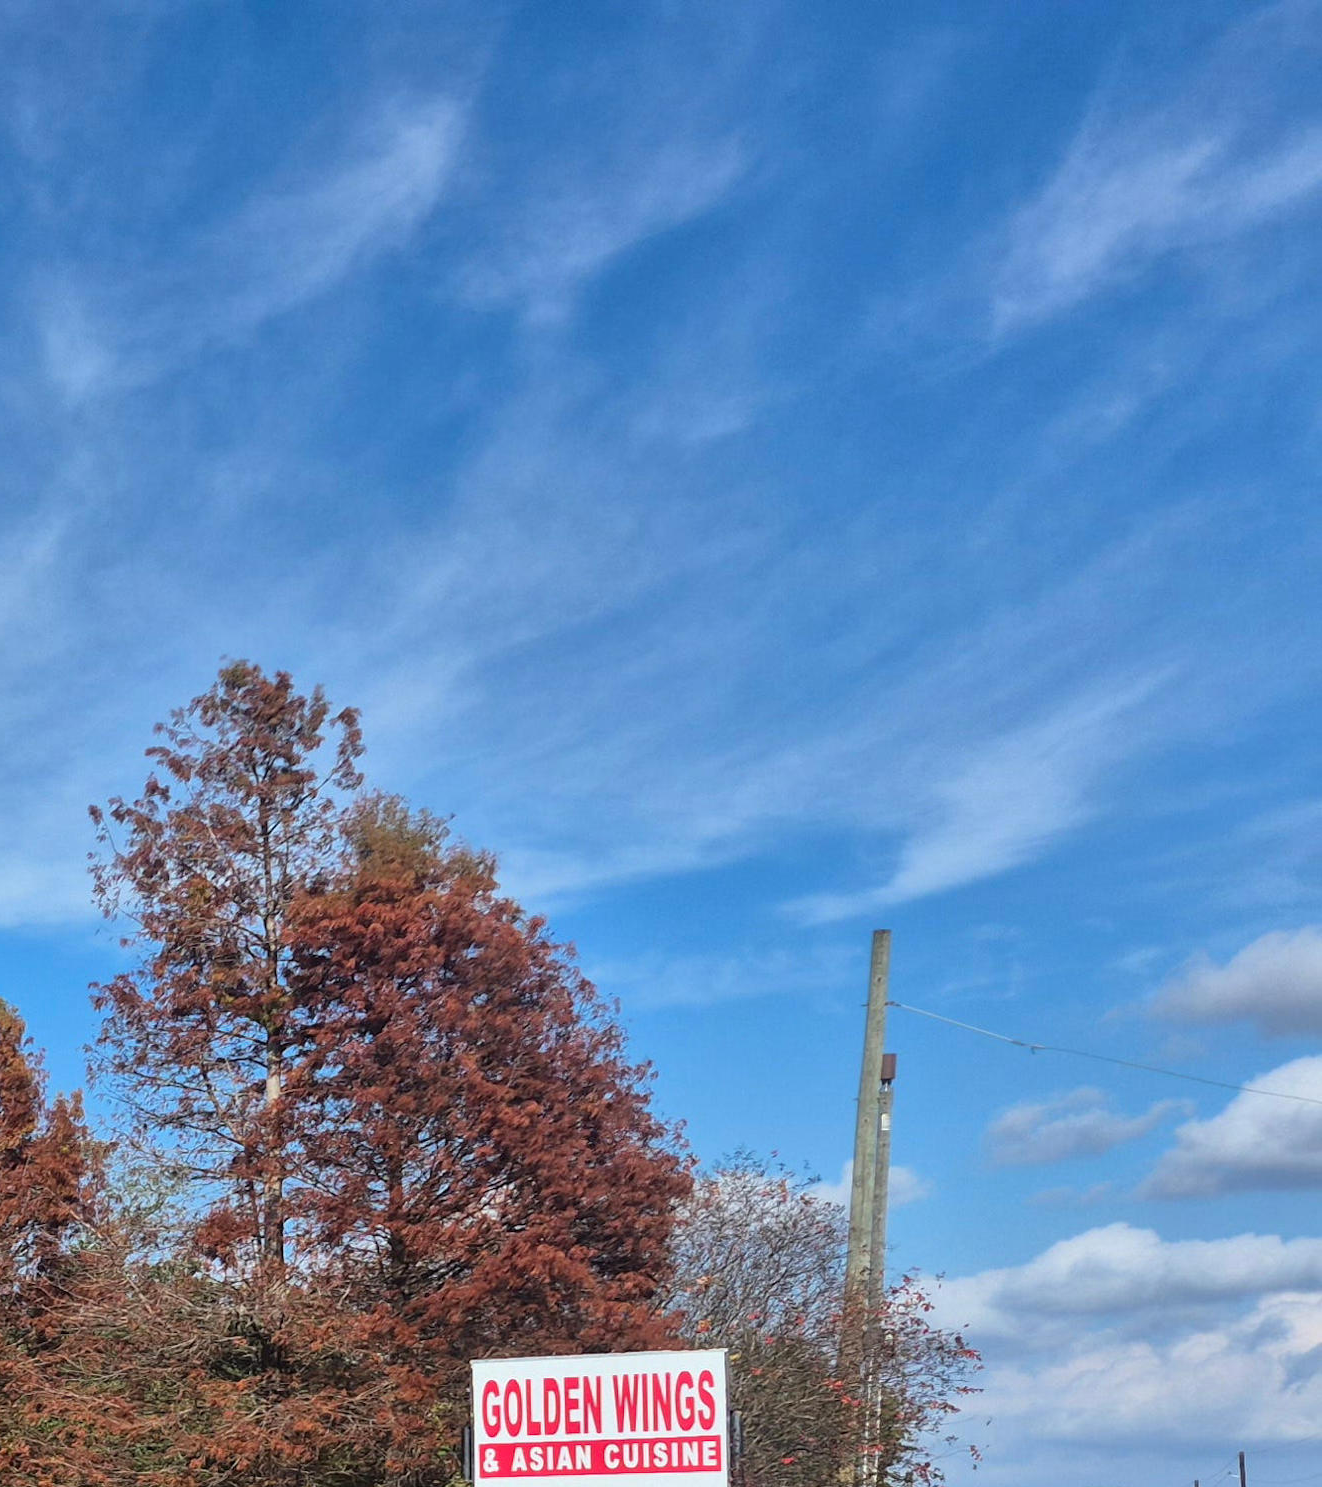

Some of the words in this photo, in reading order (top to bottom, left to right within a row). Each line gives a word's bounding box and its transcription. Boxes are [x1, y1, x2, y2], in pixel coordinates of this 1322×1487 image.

[481, 1375, 603, 1438] GOLDEN
[612, 1369, 717, 1433] WINGS
[482, 1447, 500, 1473] &
[510, 1444, 592, 1473] ASIAN
[603, 1440, 718, 1470] CUISINE
